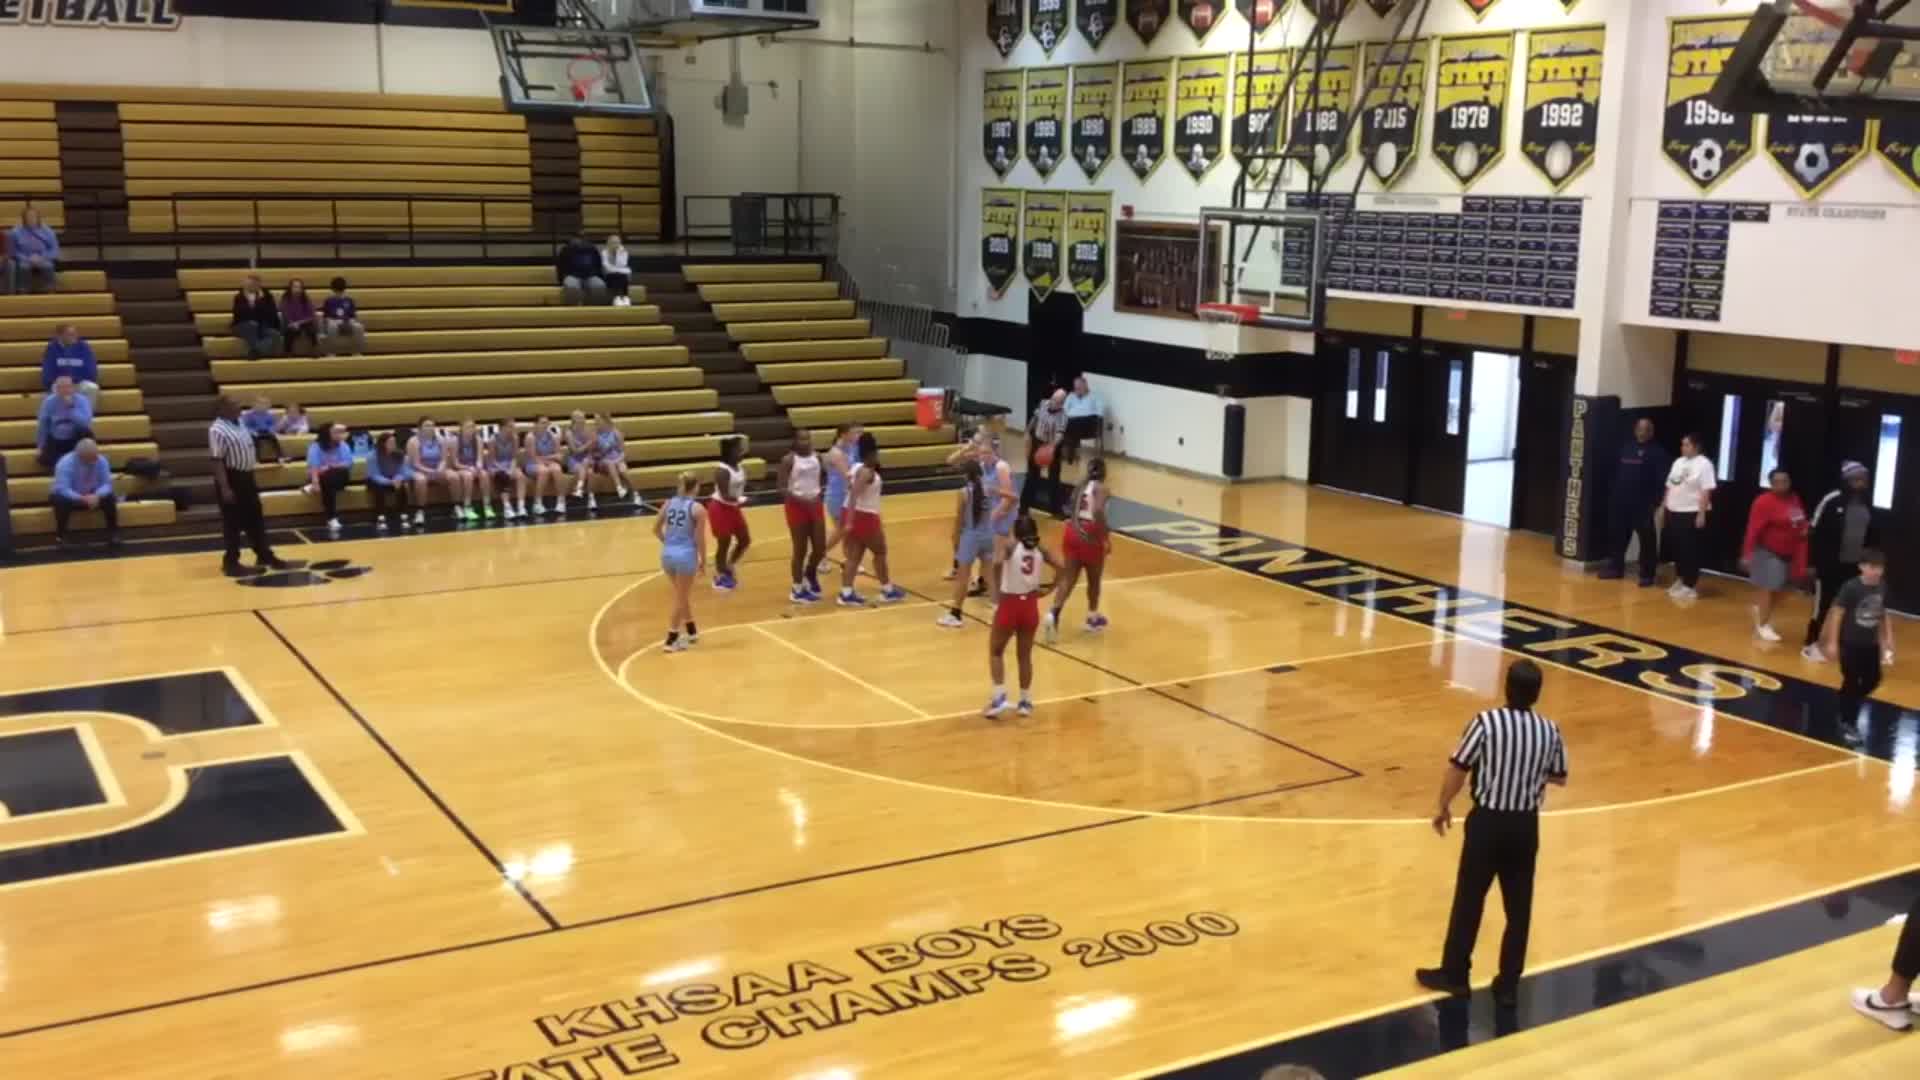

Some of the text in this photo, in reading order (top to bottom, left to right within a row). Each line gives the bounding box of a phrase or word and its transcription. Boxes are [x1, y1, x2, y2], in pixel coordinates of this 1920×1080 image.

[1451, 106, 1489, 129] 1978
[1541, 103, 1583, 127] 1992
[1563, 399, 1588, 557] PANTHERS
[667, 508, 686, 527] 22
[1021, 555, 1034, 576] 3
[1118, 520, 1783, 700] PANTHERS
[535, 914, 1062, 1047] KHSAA BOYS
[701, 953, 1051, 1050] CHAMPS
[1062, 911, 1240, 968] 2000
